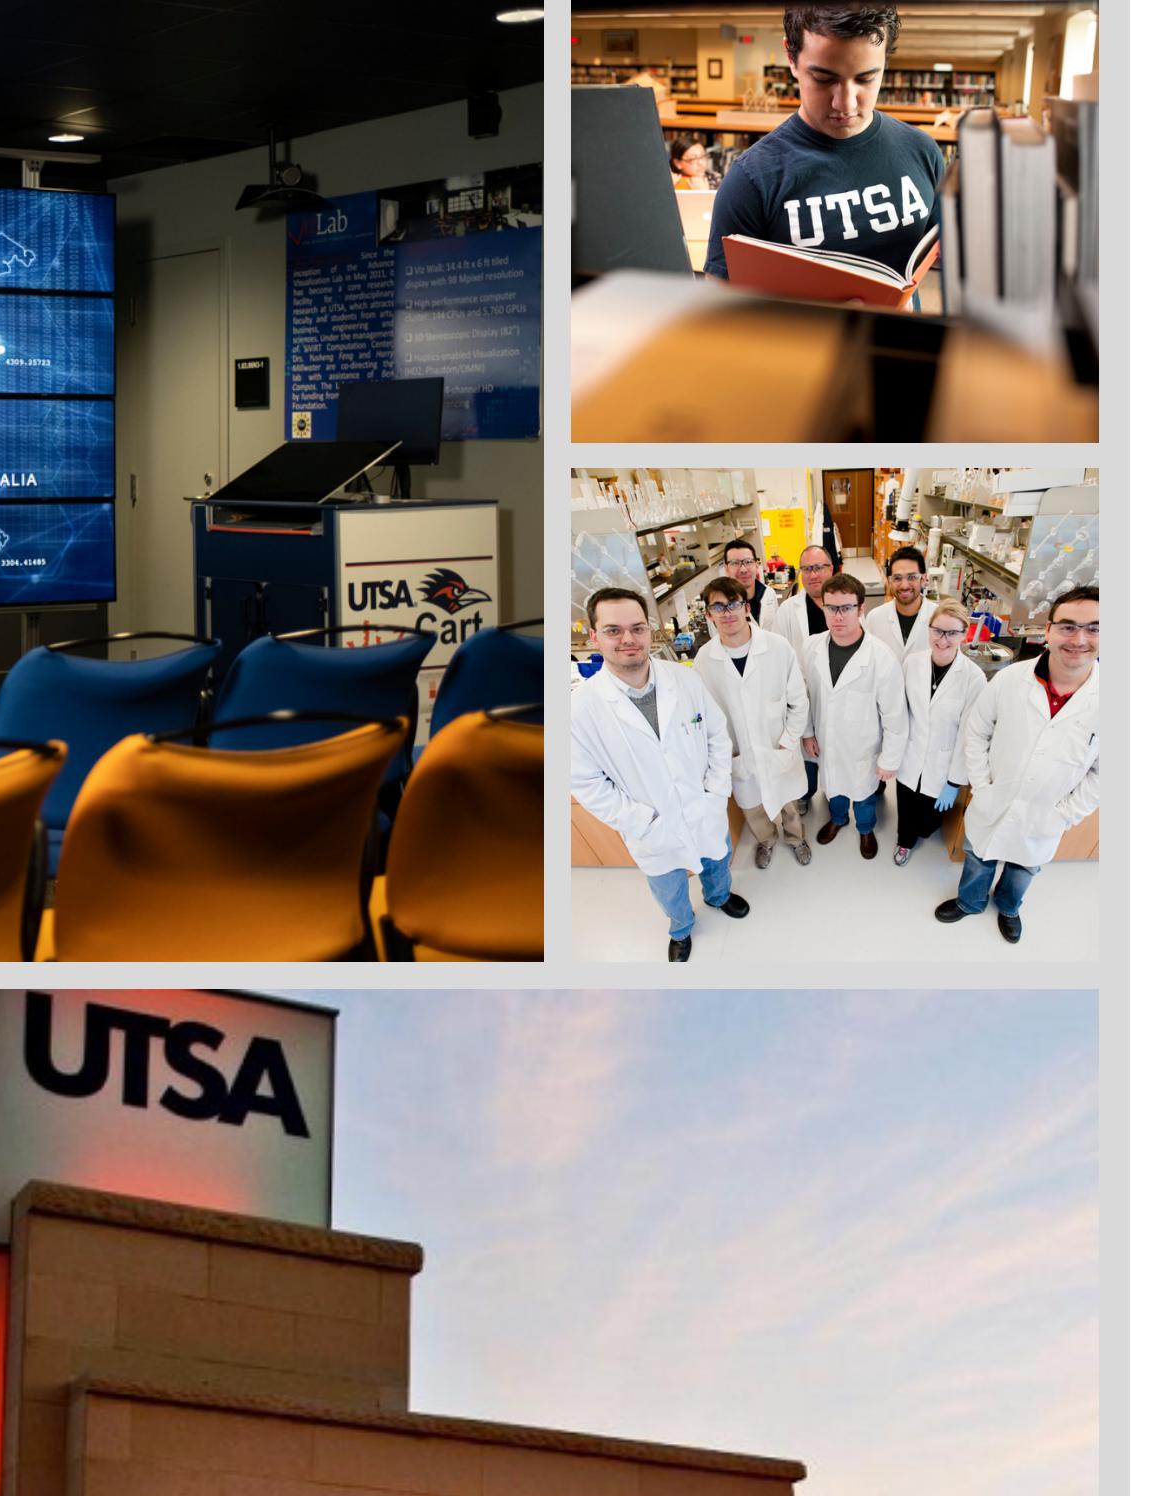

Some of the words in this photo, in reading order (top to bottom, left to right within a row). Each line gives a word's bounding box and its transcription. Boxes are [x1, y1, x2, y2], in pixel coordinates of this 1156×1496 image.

[784, 175, 929, 247] UTSA
[316, 209, 348, 235] Lab
[354, 272, 367, 281] May
[485, 270, 524, 280] resolution
[321, 382, 332, 390] The
[483, 384, 494, 393] HD
[292, 393, 300, 402] by
[301, 392, 324, 402] funding
[348, 580, 414, 611] UTSA
[415, 610, 483, 645] Cart
[24, 991, 311, 1139] UTSA
